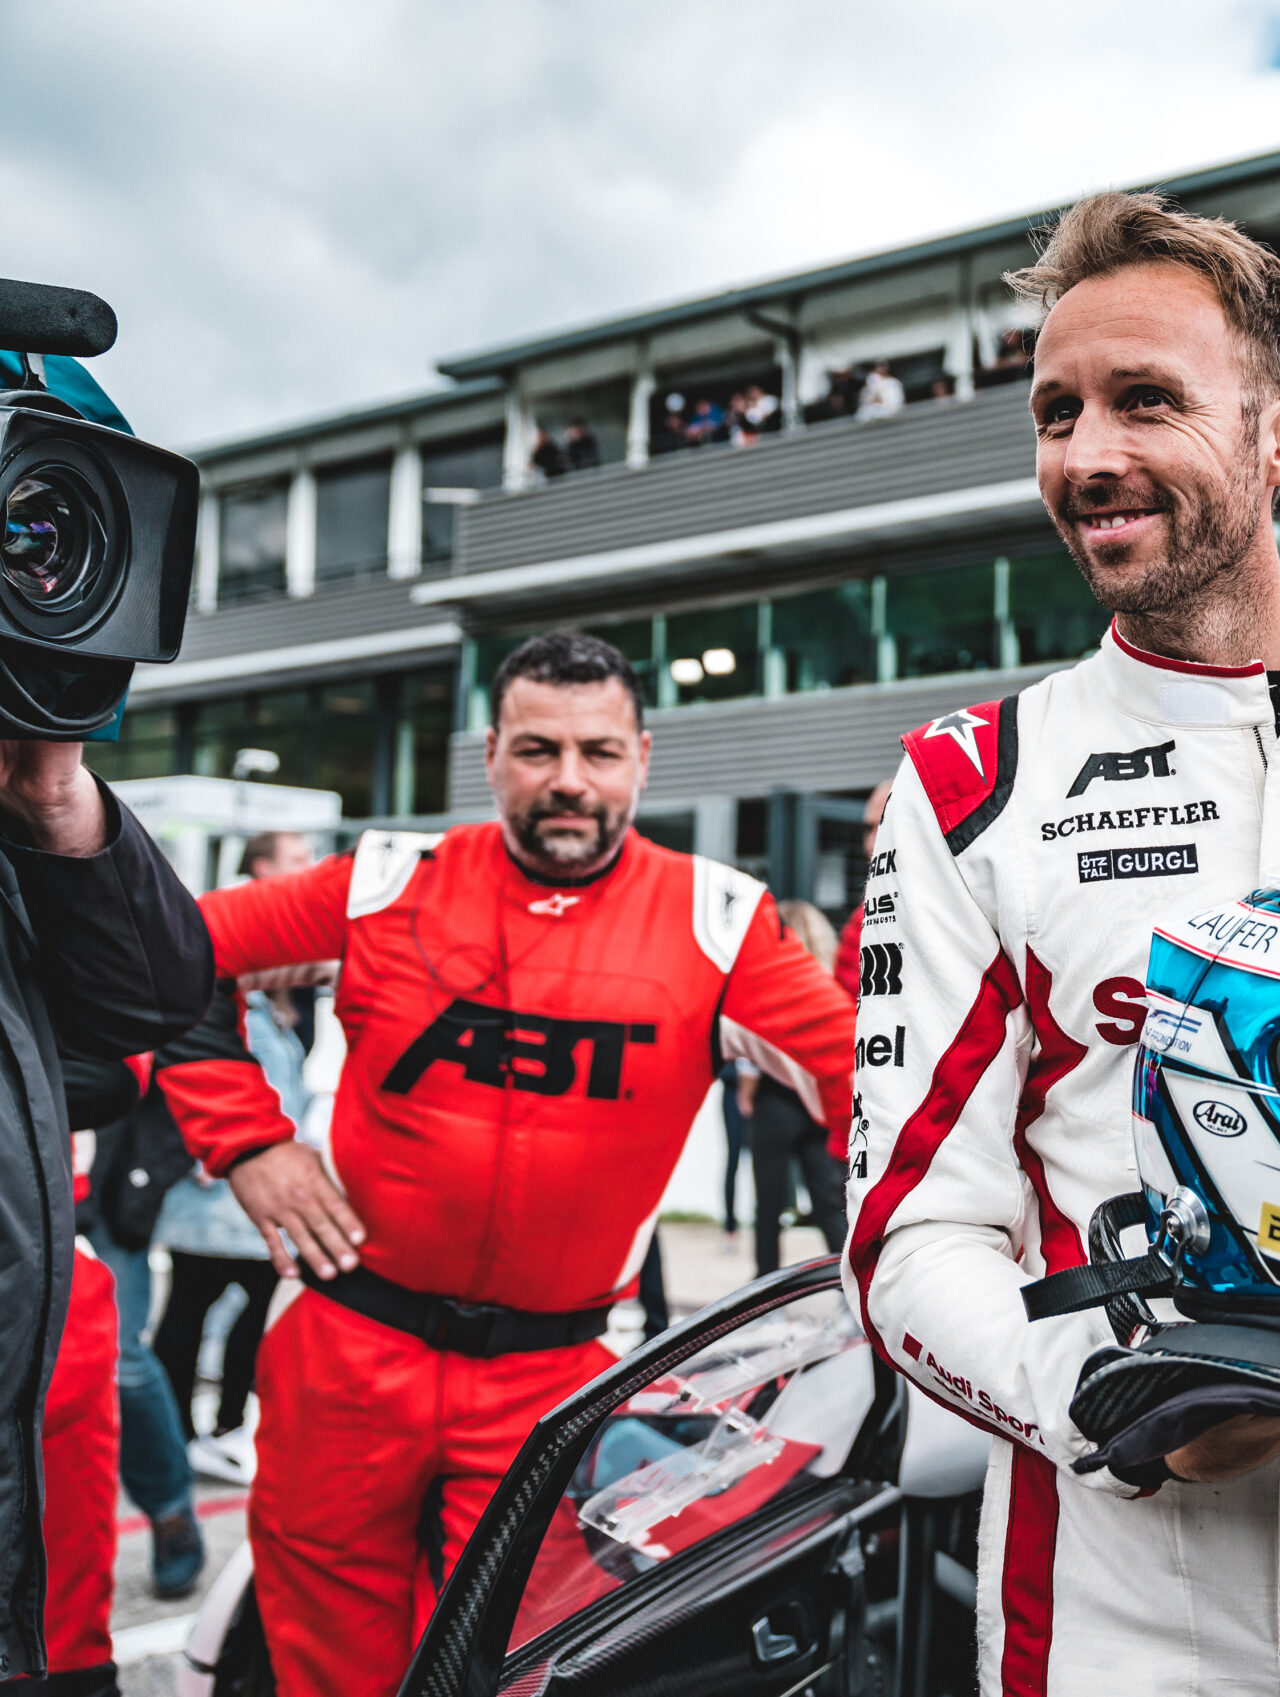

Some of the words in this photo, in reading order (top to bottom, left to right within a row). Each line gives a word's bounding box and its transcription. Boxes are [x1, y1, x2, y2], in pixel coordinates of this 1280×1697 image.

[1066, 740, 1177, 799] ABT
[1041, 800, 1220, 842] SCHAEFFLER
[1080, 867, 1108, 879] TAL
[1117, 850, 1196, 873] GURGL
[1187, 910, 1278, 953] LAUFER
[381, 996, 657, 1101] ABT
[1195, 1103, 1240, 1131] Arai
[926, 1351, 973, 1400] Audi
